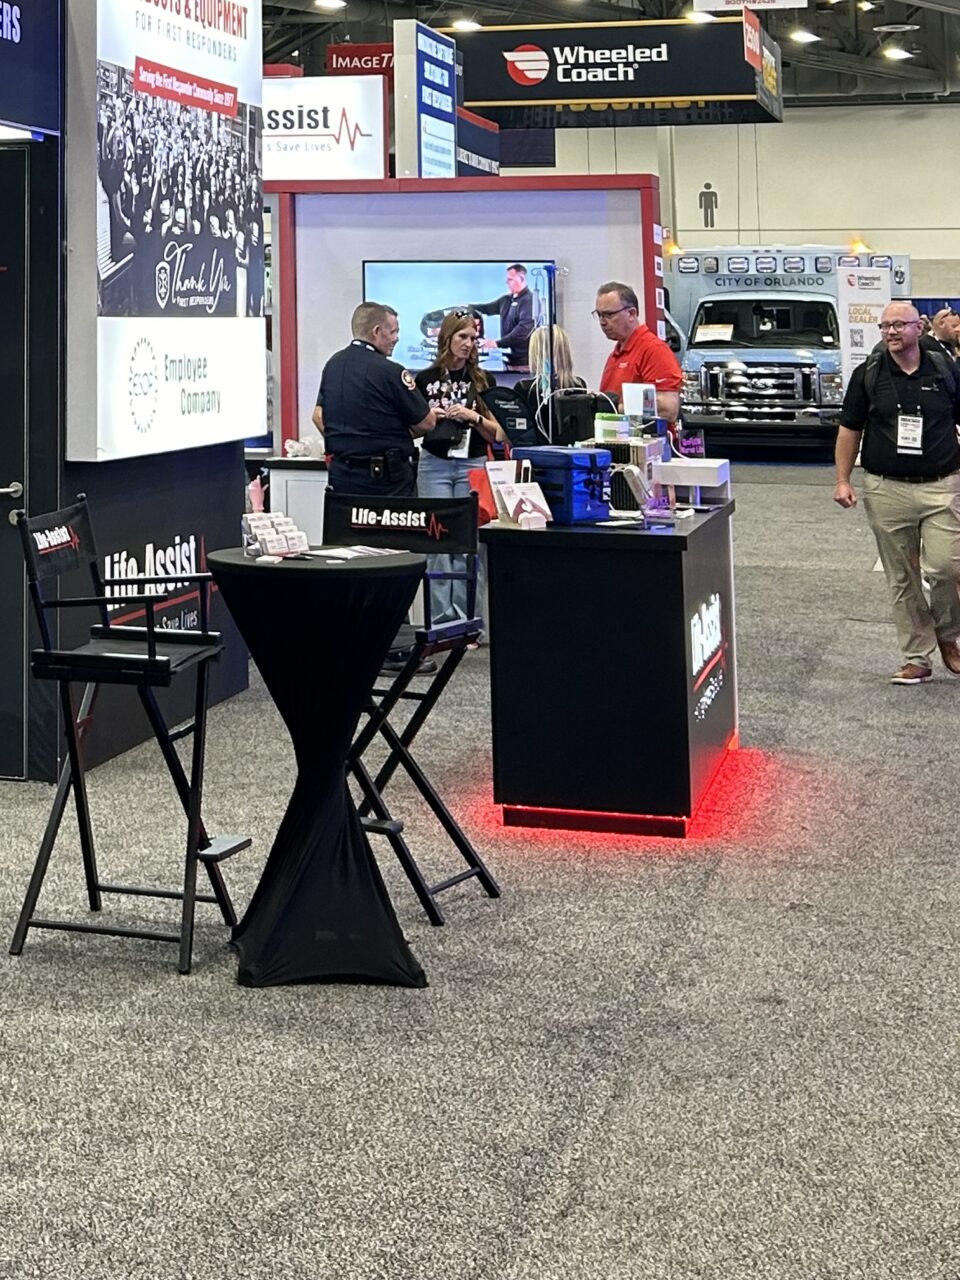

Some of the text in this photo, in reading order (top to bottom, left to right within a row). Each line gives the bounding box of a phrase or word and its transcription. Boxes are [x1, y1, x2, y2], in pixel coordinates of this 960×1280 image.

[135, 10, 237, 63] FOR FIRST RESPONDERS
[553, 43, 668, 65] Wheeled
[556, 63, 635, 83] Coach
[275, 141, 301, 152] Save
[305, 141, 332, 152] Lives
[164, 240, 207, 304] Thank
[715, 276, 825, 287] CITY OF ORLANDO
[848, 307, 872, 316] LOCAL
[848, 315, 879, 324] DEALER
[165, 353, 208, 383] Employee
[181, 388, 220, 416] Company
[351, 507, 427, 527] Life-Assist
[180, 609, 198, 630] Lives
